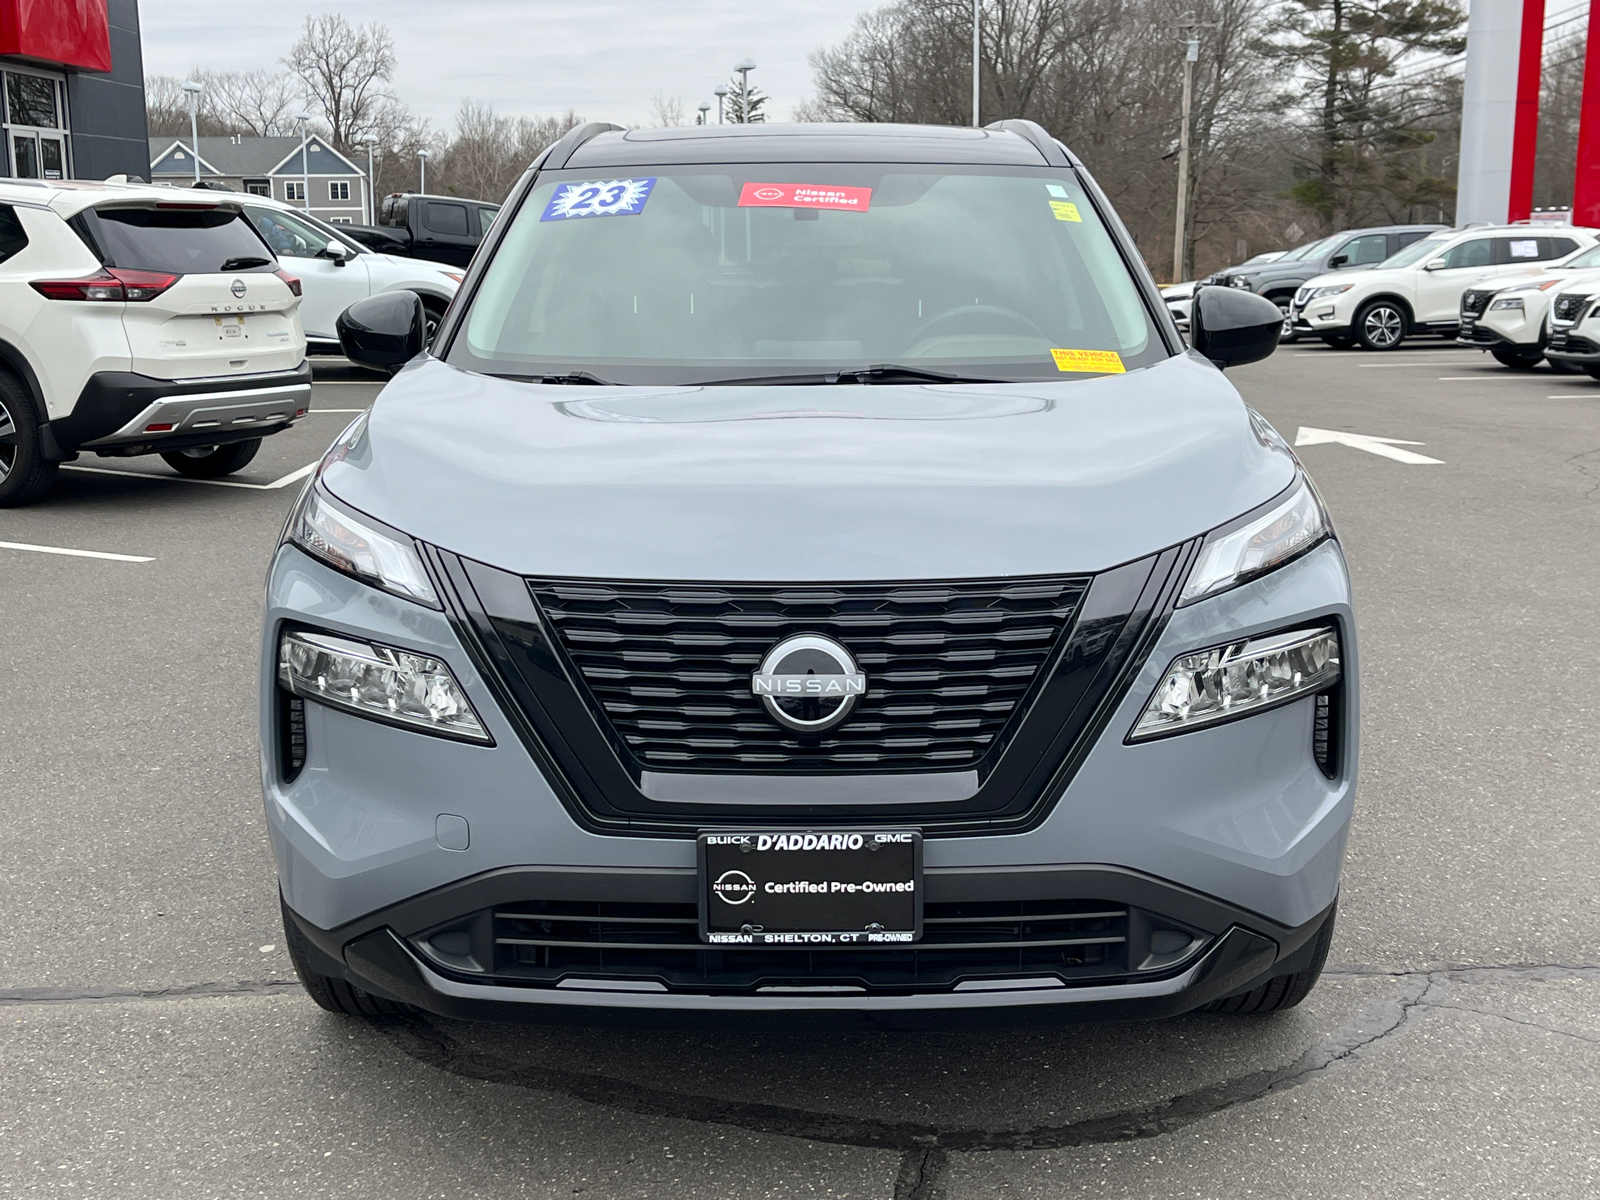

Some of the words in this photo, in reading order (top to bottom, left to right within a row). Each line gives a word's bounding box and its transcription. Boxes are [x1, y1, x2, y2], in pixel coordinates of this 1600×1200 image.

[569, 185, 627, 210] 23
[795, 189, 846, 197] Nissan
[793, 195, 858, 205] Certified
[756, 678, 862, 693] NISSAN
[707, 836, 751, 845] BUICK
[756, 834, 864, 851] D'ADDARIO
[874, 834, 912, 843] GMC
[713, 883, 757, 891] NISSAN
[764, 881, 828, 893] Certified
[831, 880, 915, 893] Pre-Owned
[709, 934, 753, 943] NISSAN
[764, 933, 836, 943] SHELTON,
[839, 933, 859, 942] CT
[868, 933, 913, 942] PRE-OWNED
